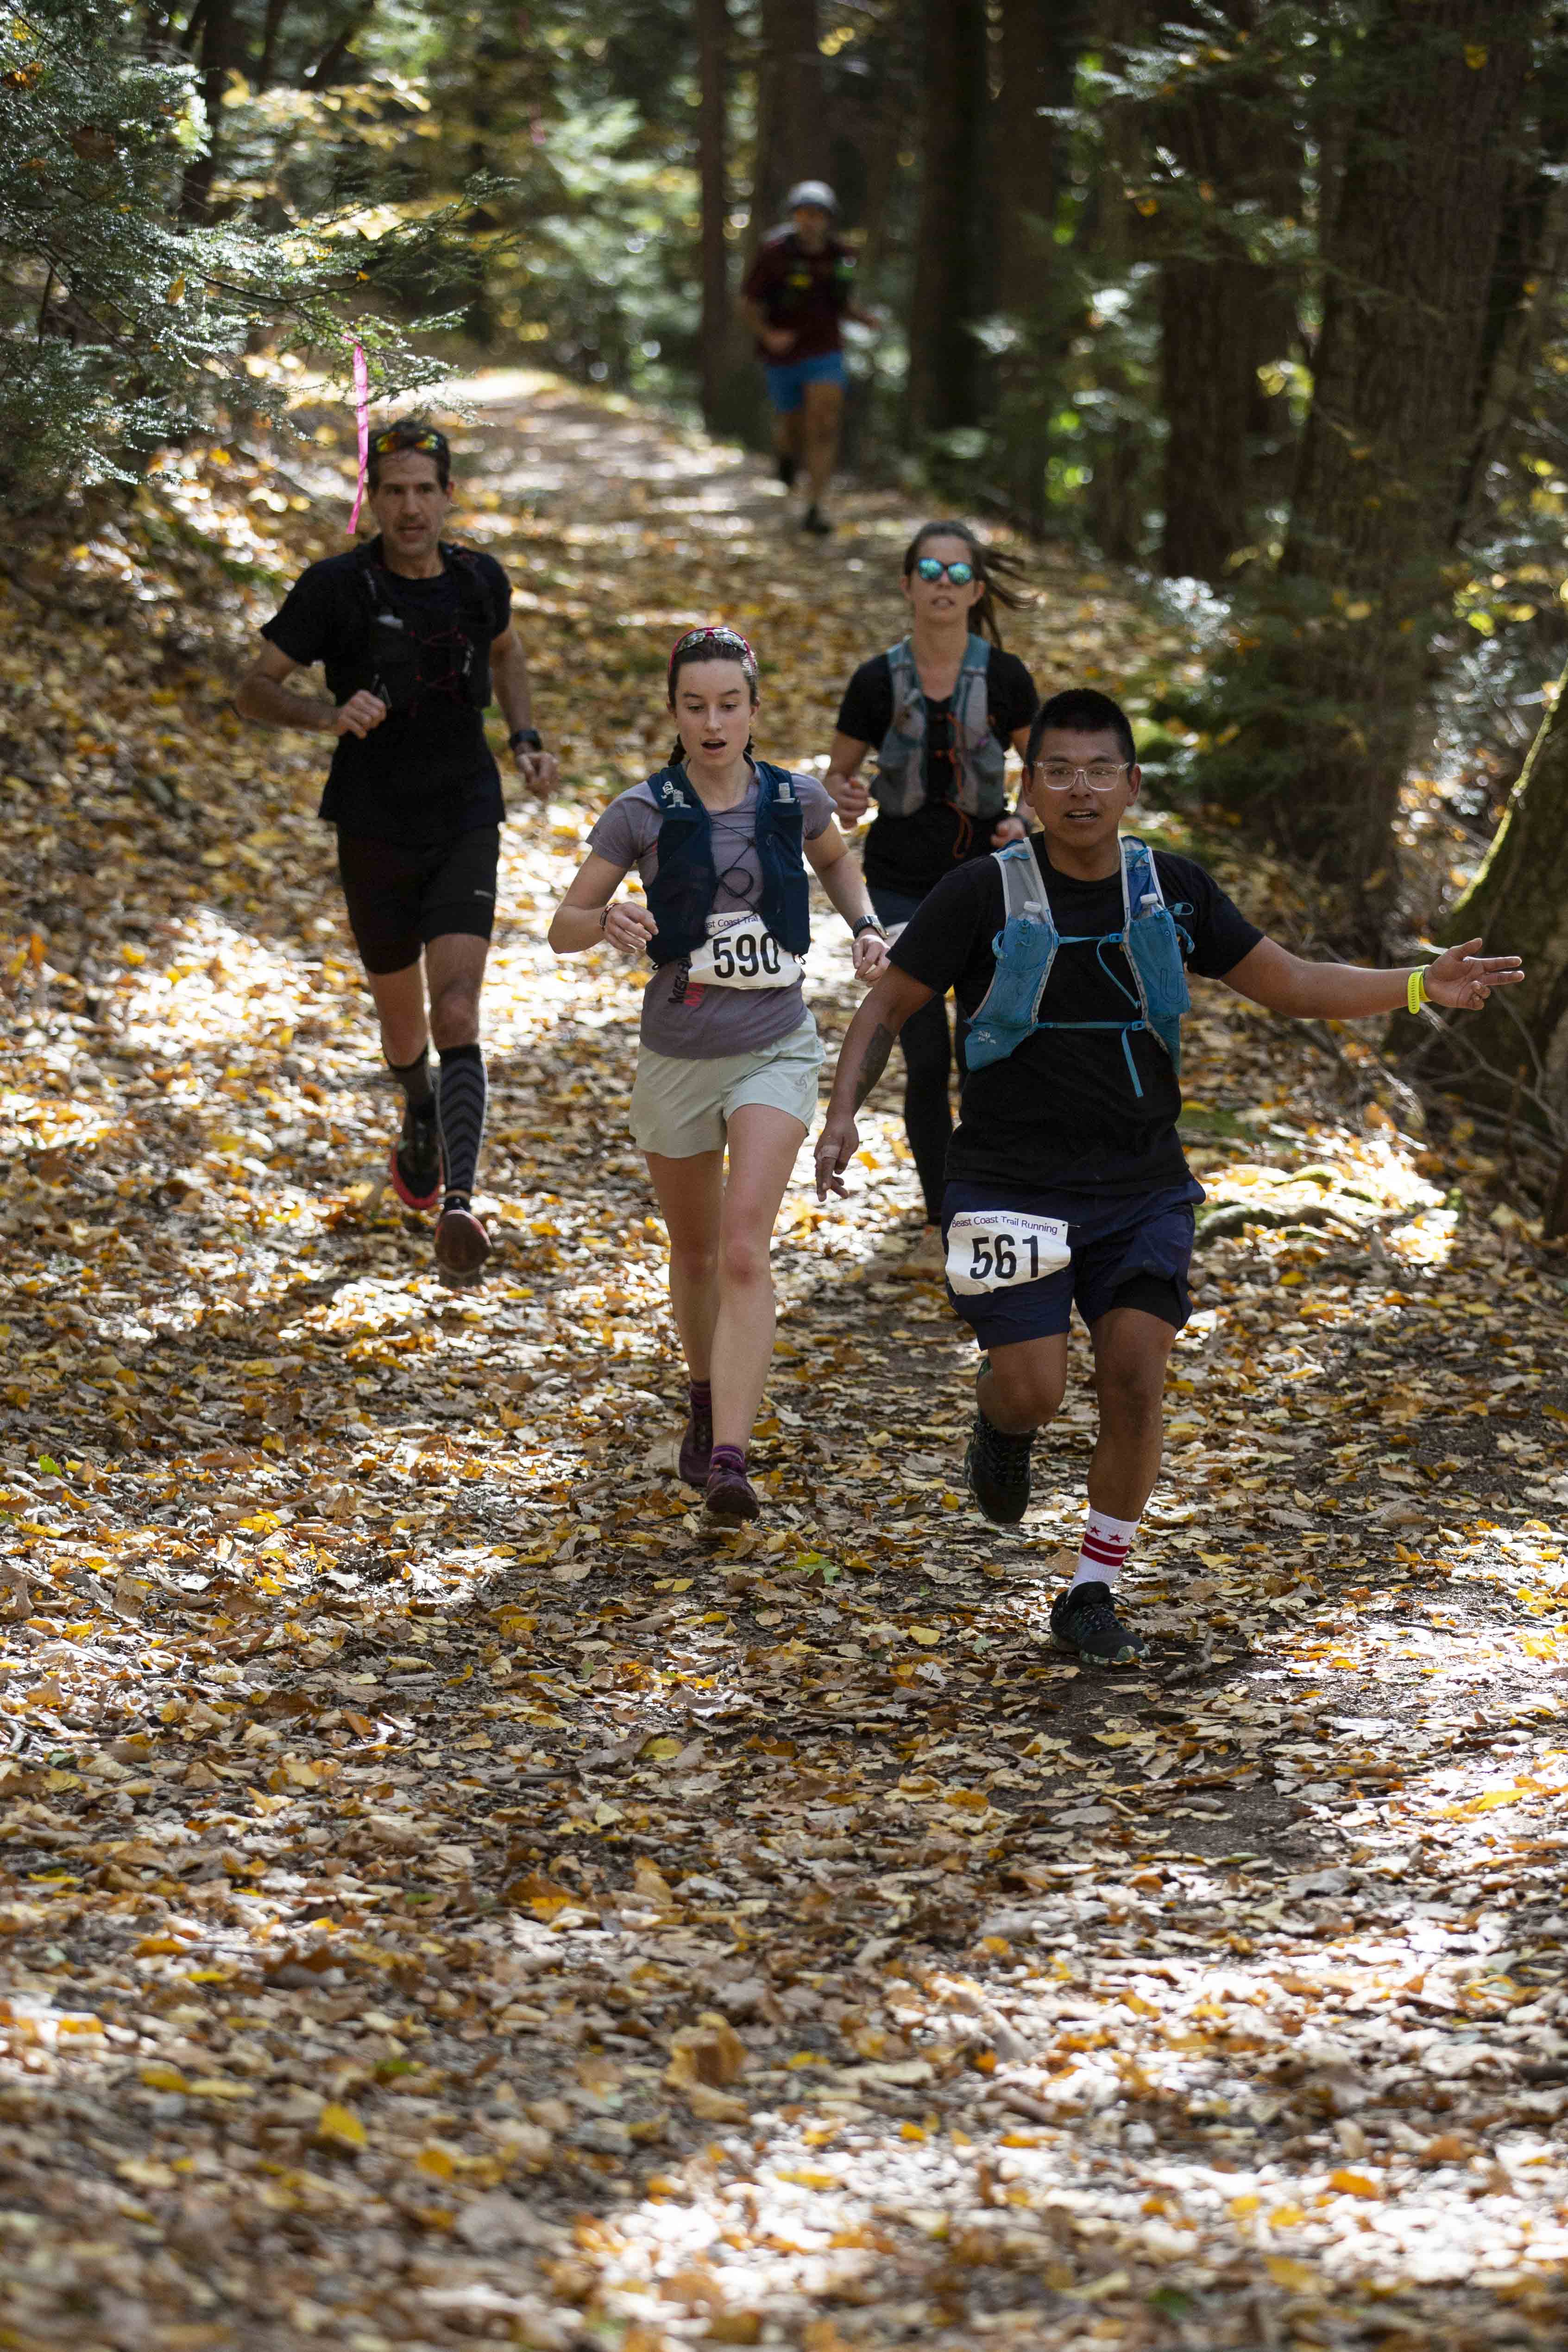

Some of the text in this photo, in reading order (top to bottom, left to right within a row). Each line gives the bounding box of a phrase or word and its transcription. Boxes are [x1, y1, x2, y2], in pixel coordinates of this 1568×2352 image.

[718, 918, 740, 927] Coast
[713, 934, 781, 978] 590
[952, 1216, 1058, 1235] Beast Coast Trail Running
[970, 1234, 1039, 1279] 561
